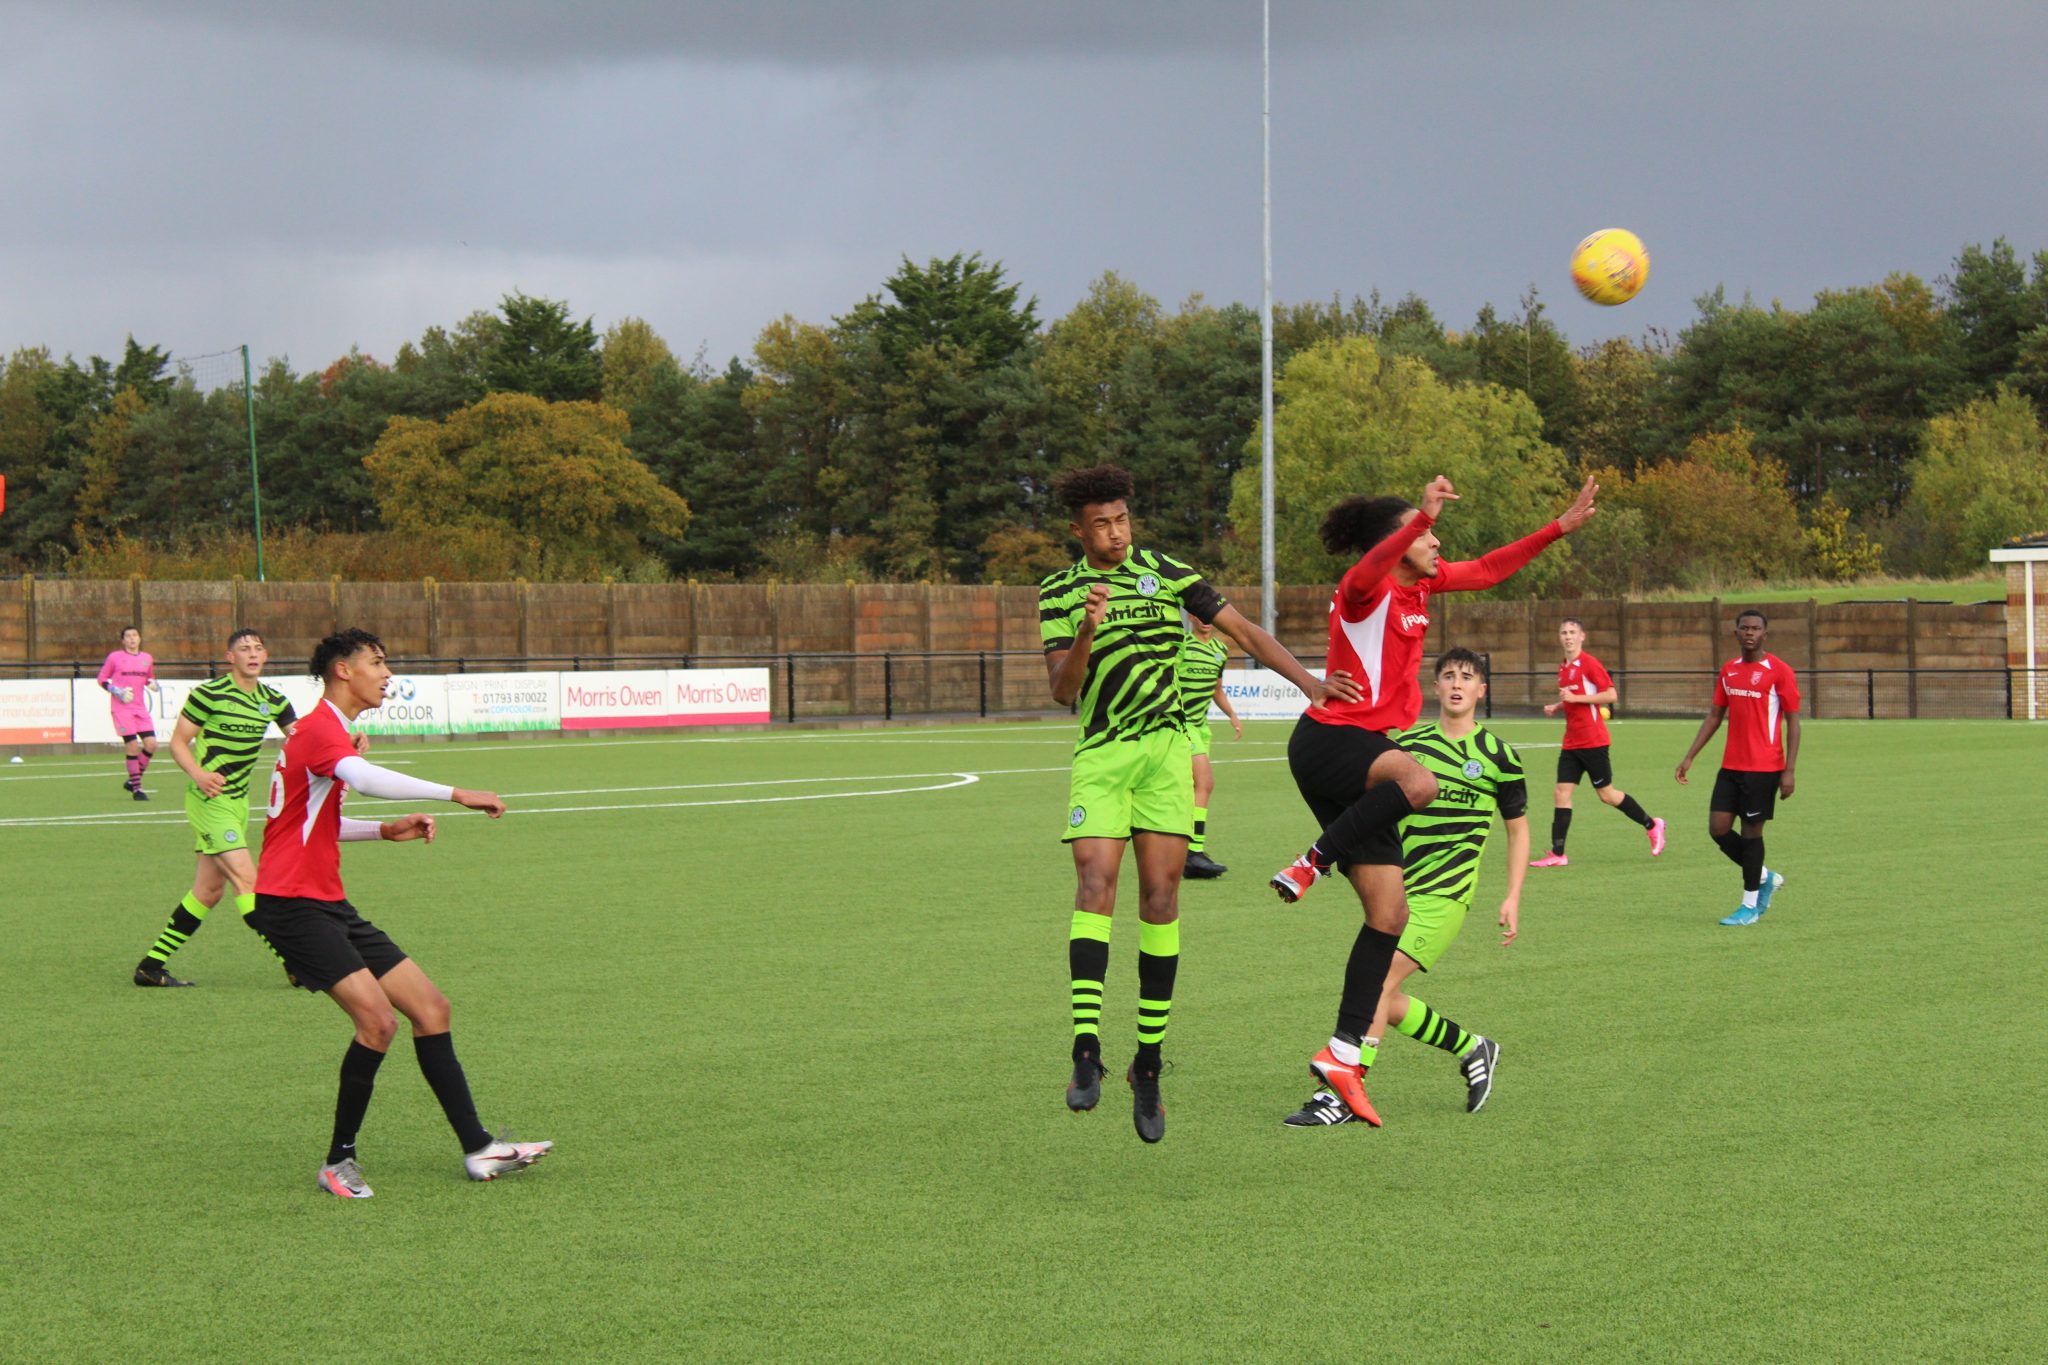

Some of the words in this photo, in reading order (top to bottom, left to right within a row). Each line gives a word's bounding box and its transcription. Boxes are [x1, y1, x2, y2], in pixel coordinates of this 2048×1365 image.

[1104, 601, 1166, 622] otricity
[483, 680, 508, 690] PRINT
[514, 679, 548, 690] DISPLAY
[1222, 686, 1260, 697] REAM
[482, 693, 512, 704] 01793
[514, 692, 548, 703] 870022
[567, 685, 617, 707] Morris
[620, 685, 662, 706] Owen
[677, 683, 723, 704] Morris
[726, 682, 767, 703] Owen
[359, 706, 384, 720] OPY
[387, 705, 434, 720] COLOR
[219, 722, 268, 734] ecotric
[1437, 785, 1480, 808] ricity
